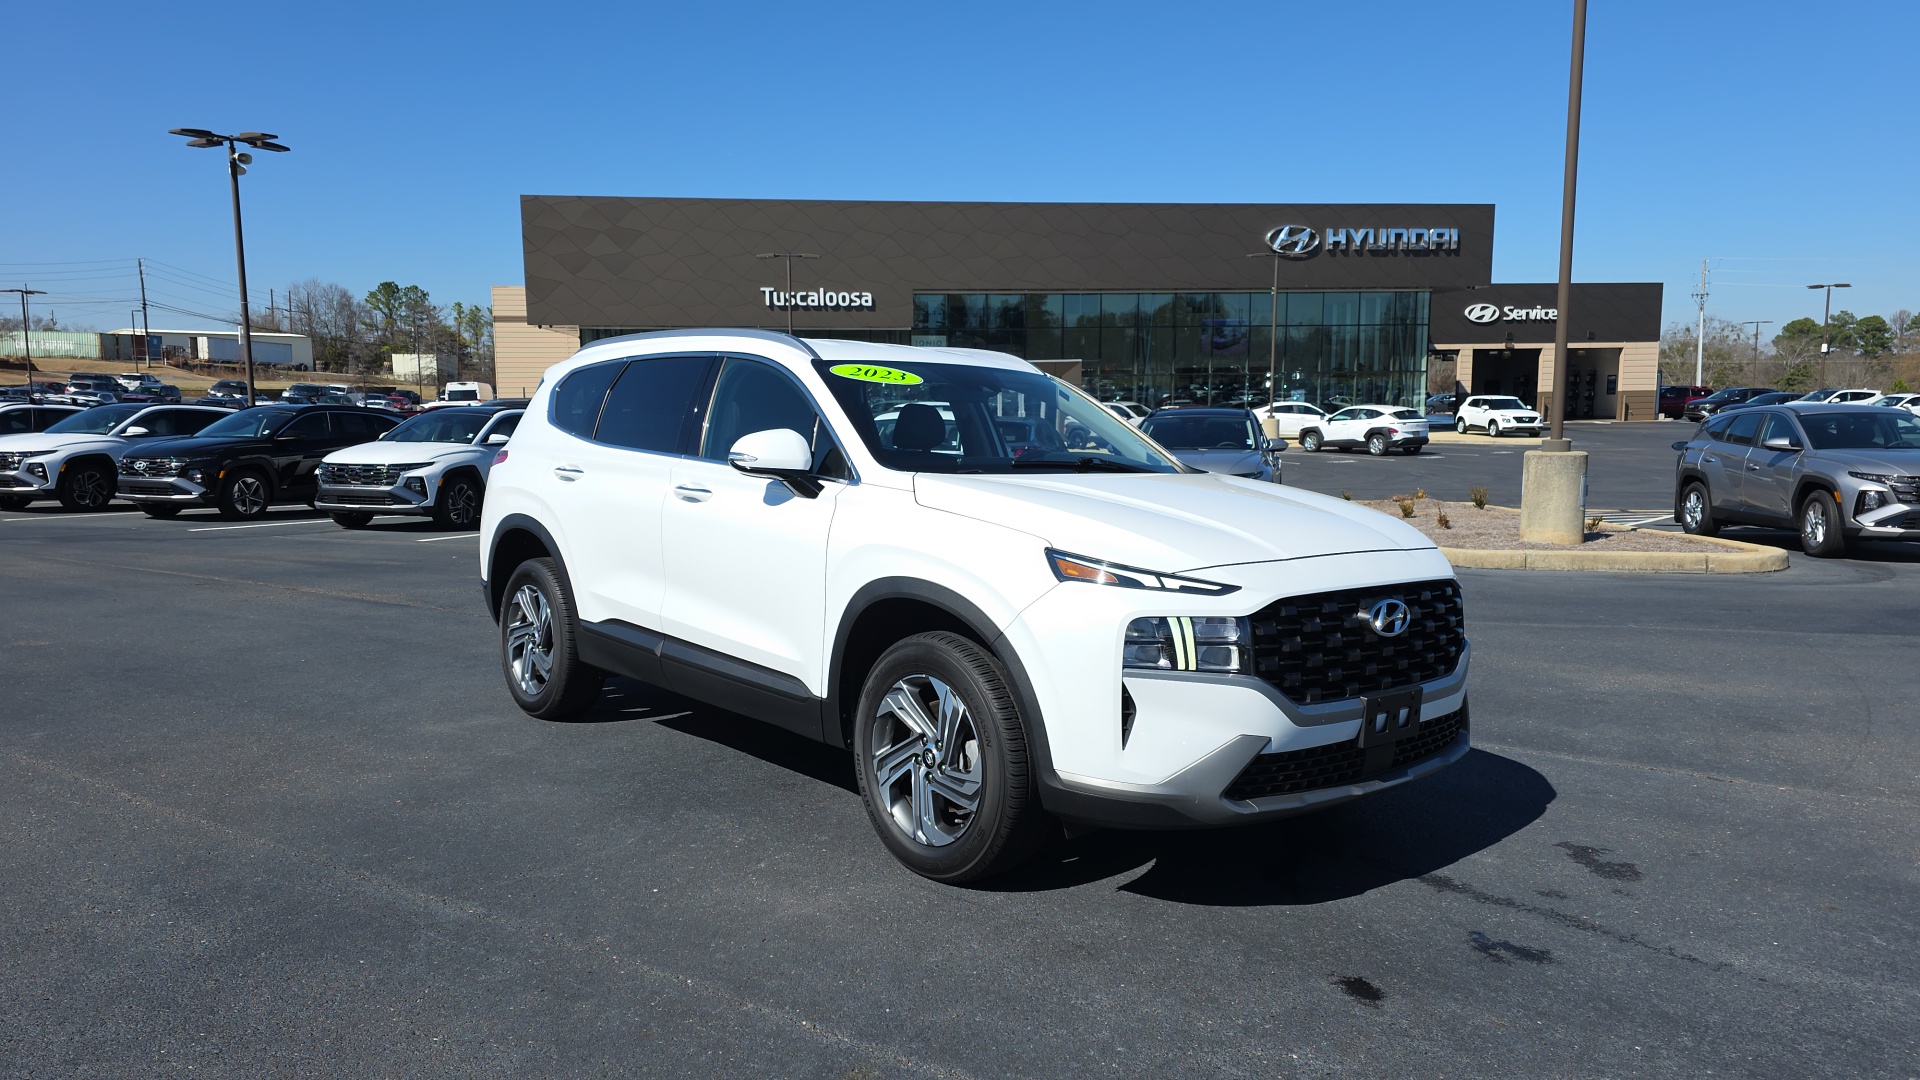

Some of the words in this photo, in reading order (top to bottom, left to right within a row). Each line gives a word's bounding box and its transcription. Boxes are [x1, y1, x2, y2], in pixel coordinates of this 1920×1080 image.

[1326, 228, 1459, 250] HYUNDAI
[760, 287, 873, 307] Tuscaloosa
[1503, 305, 1558, 320] Service
[15, 339, 37, 349] CHNA
[849, 366, 907, 381] 2023
[962, 687, 992, 748] ALL-SEASON
